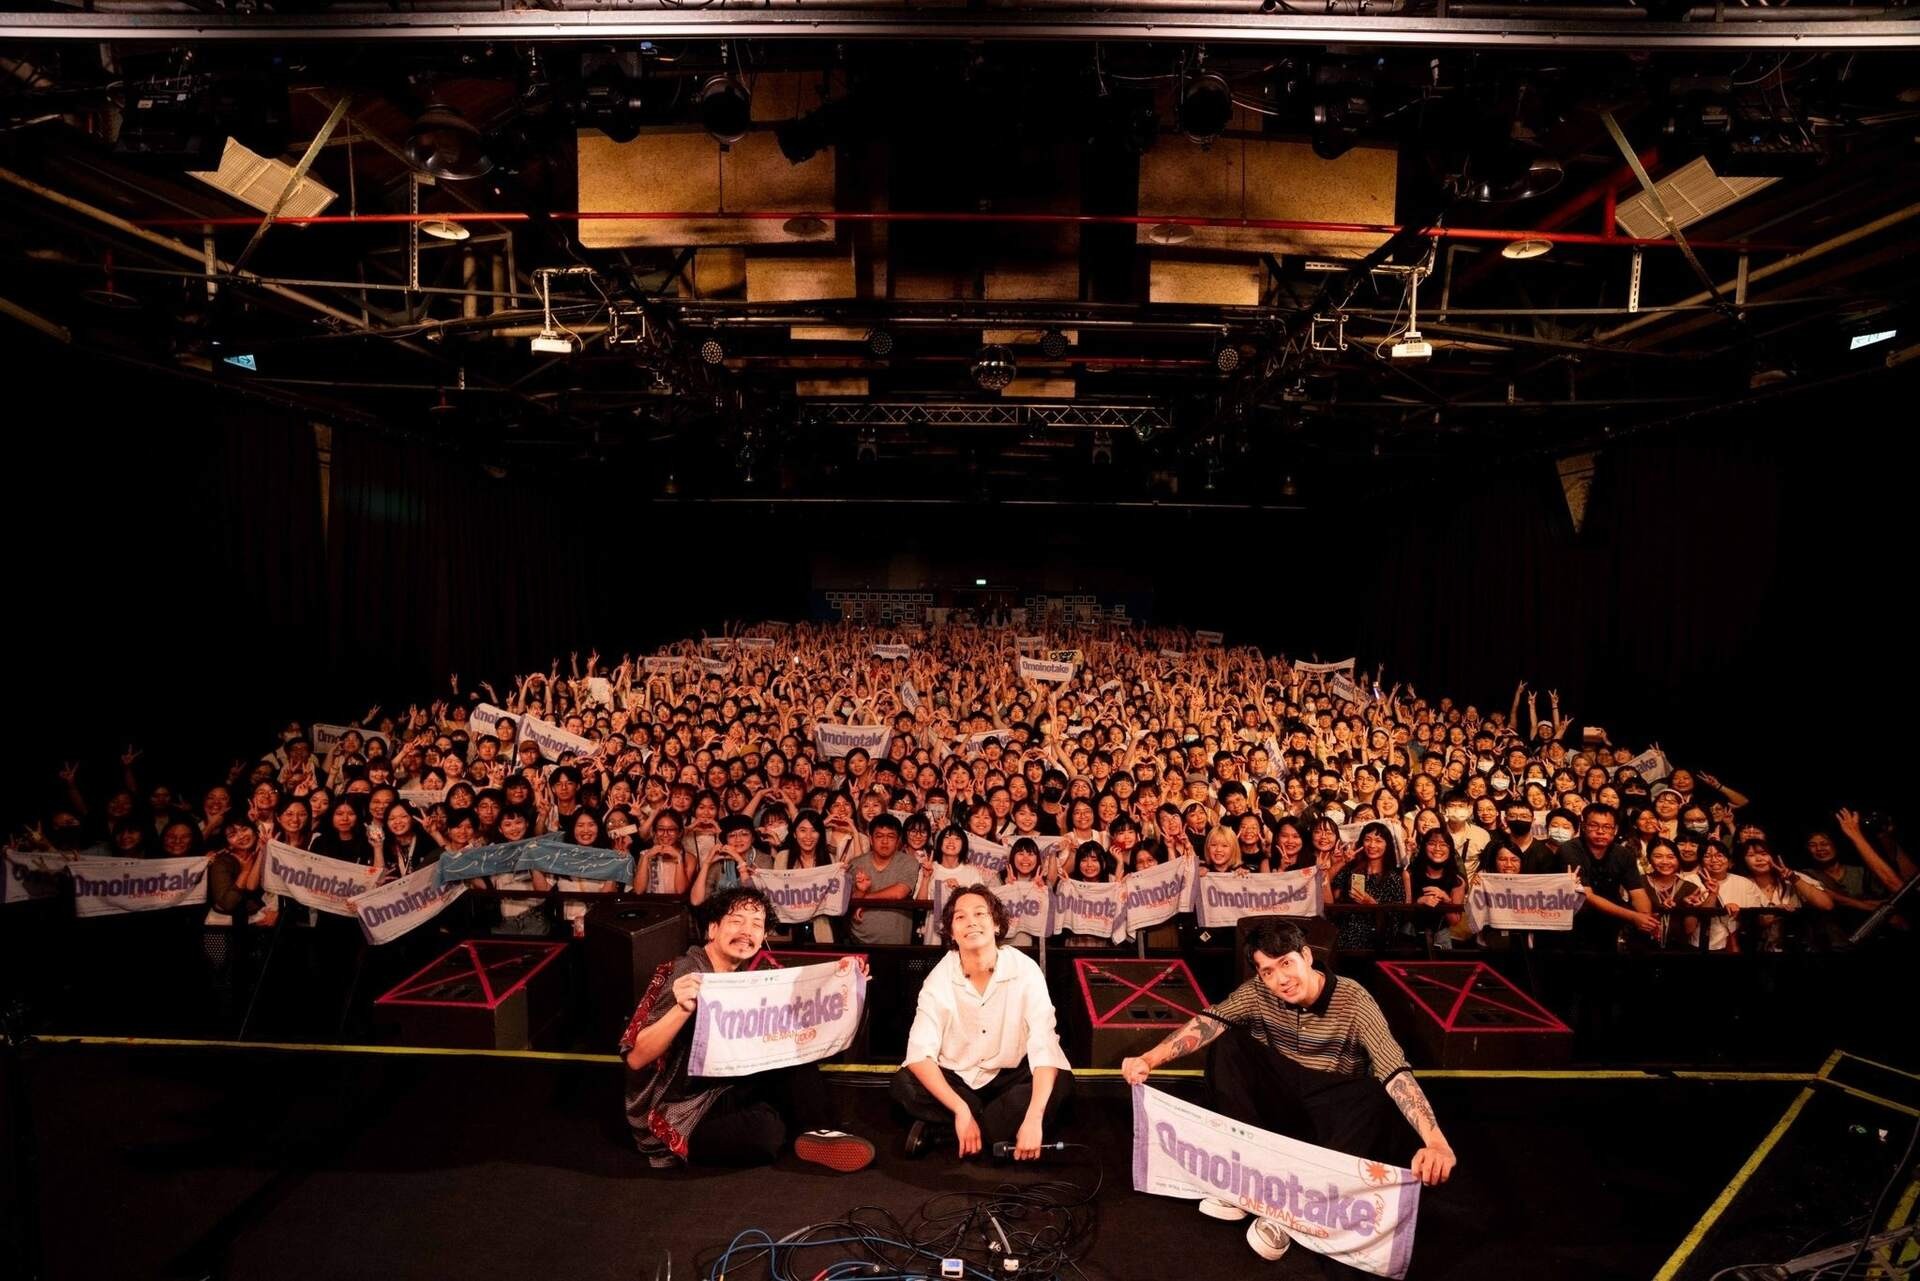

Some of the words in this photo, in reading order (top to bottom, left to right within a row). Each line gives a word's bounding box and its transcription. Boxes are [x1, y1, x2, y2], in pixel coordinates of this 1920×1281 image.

[1156, 1121, 1377, 1237] Omoinotake
[1240, 1195, 1265, 1214] ONE
[1265, 1205, 1293, 1227] MAN
